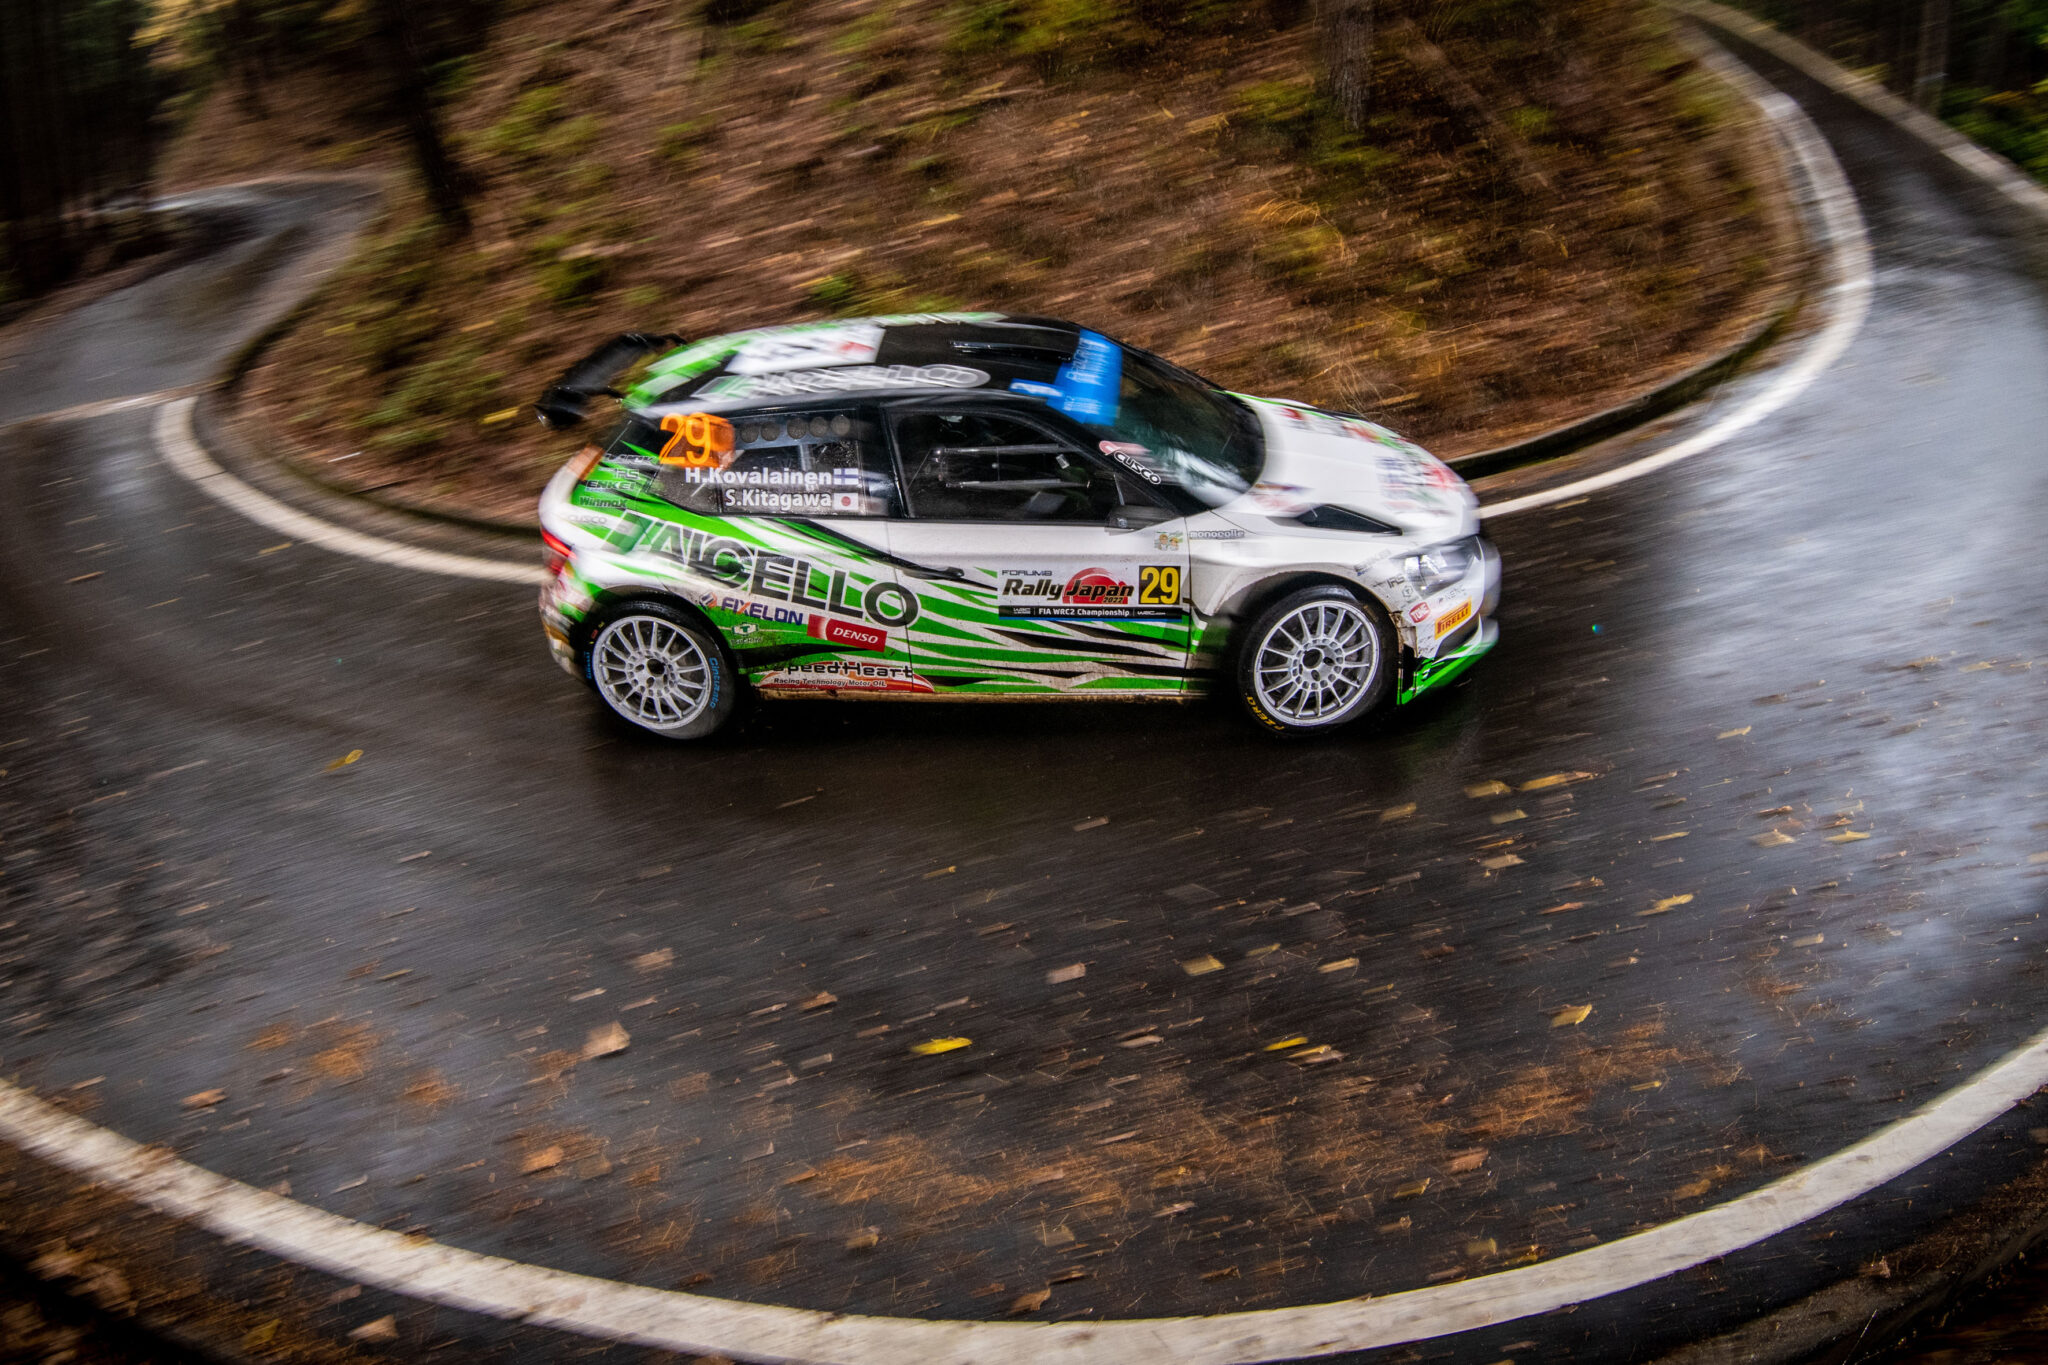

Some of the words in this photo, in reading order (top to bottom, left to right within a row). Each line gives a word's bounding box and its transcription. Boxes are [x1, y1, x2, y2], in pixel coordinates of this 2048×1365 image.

[660, 412, 711, 465] 29
[685, 467, 832, 486] H.Kovalainen
[1114, 451, 1161, 484] CUSCO
[725, 489, 832, 511] S.Kitagawa
[1002, 578, 1064, 601] Rally
[1066, 579, 1134, 601] Japan
[1140, 566, 1177, 605] 29
[721, 597, 804, 626] FIXELON
[1053, 608, 1075, 616] WRC2
[1076, 608, 1130, 617] Championship
[1437, 602, 1469, 634] PIRELLI
[832, 626, 879, 645] DENSO
[773, 677, 801, 686] Racing
[802, 678, 847, 688] Technology
[848, 679, 871, 687] Motor
